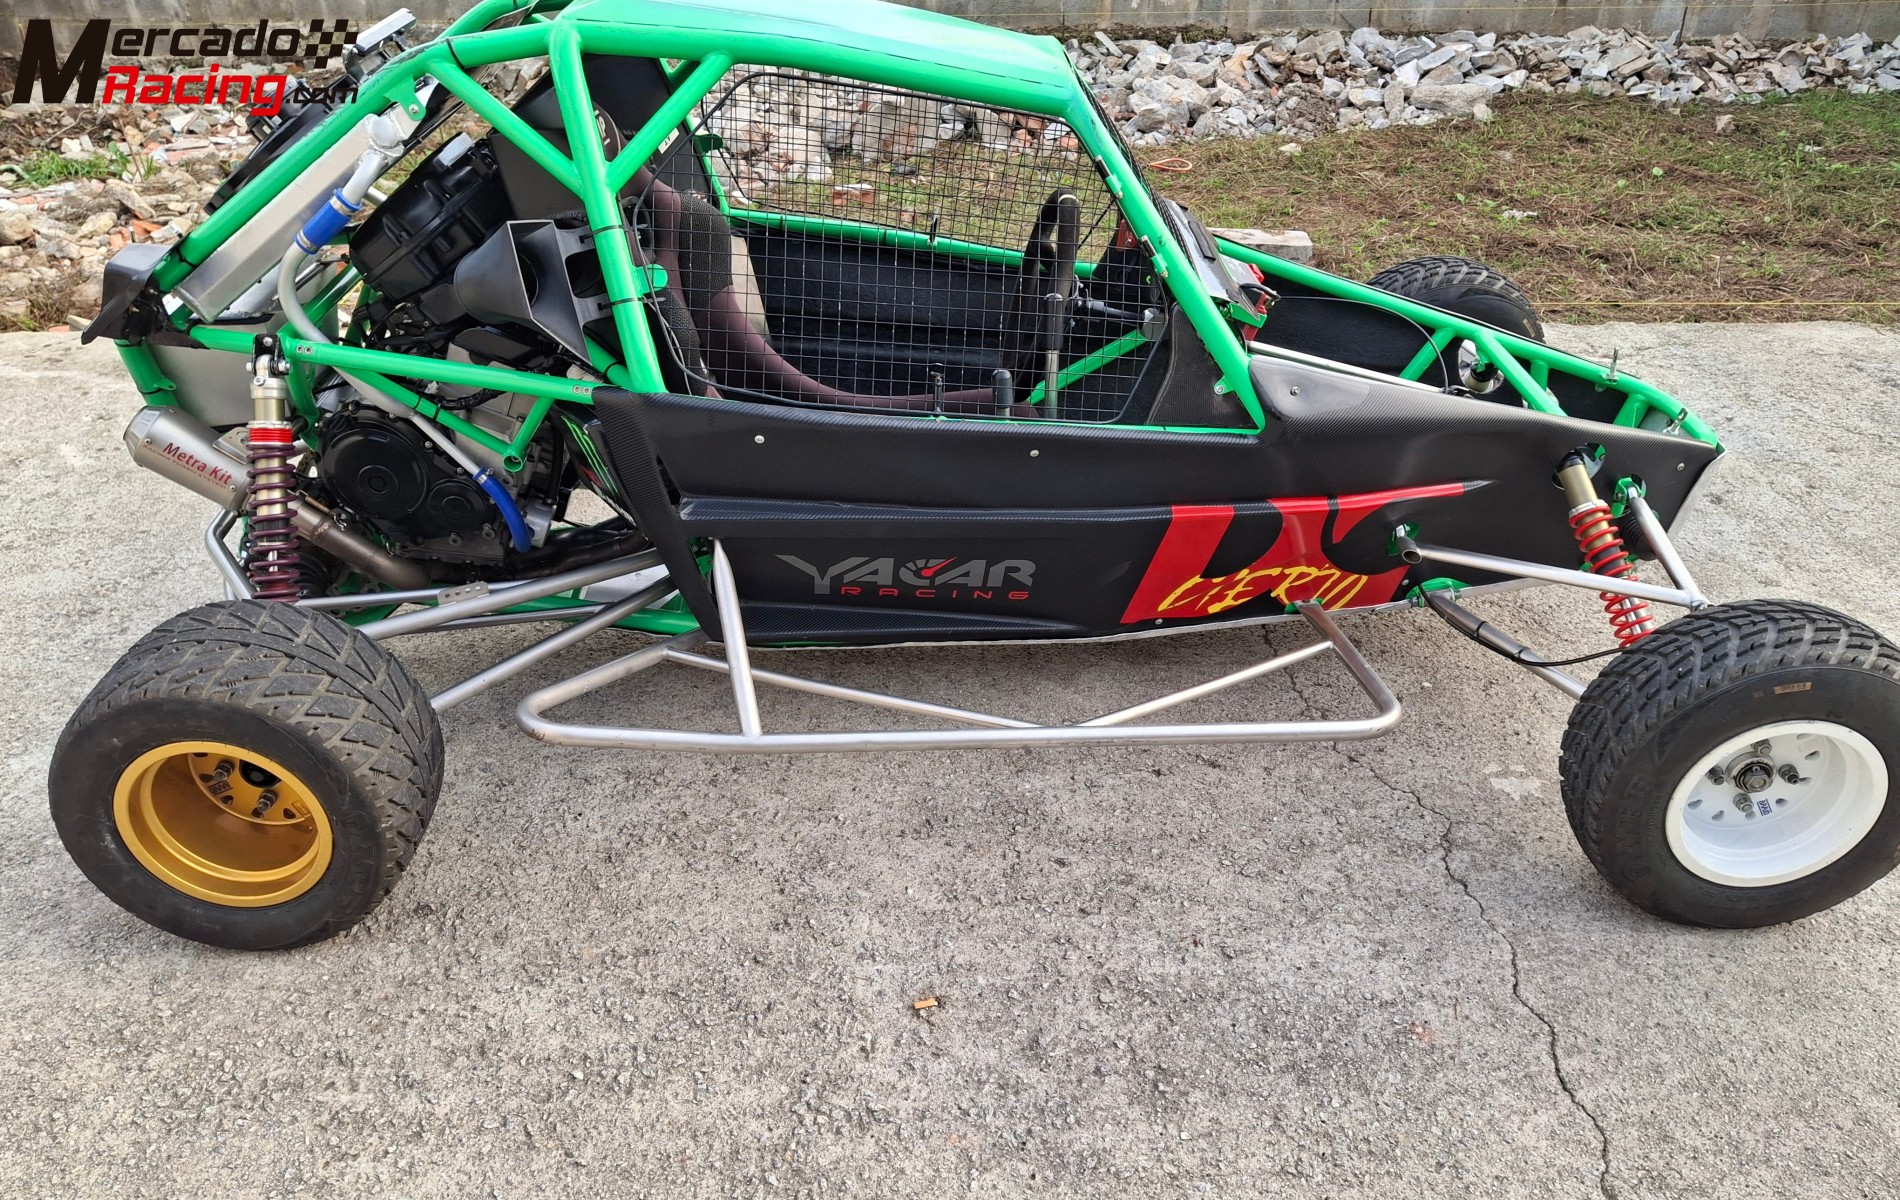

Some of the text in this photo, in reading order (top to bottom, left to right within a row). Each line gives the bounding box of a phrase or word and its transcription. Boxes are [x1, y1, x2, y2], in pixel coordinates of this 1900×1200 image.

[163, 442, 232, 485] Metra Kit
[841, 586, 1030, 600] RACING
